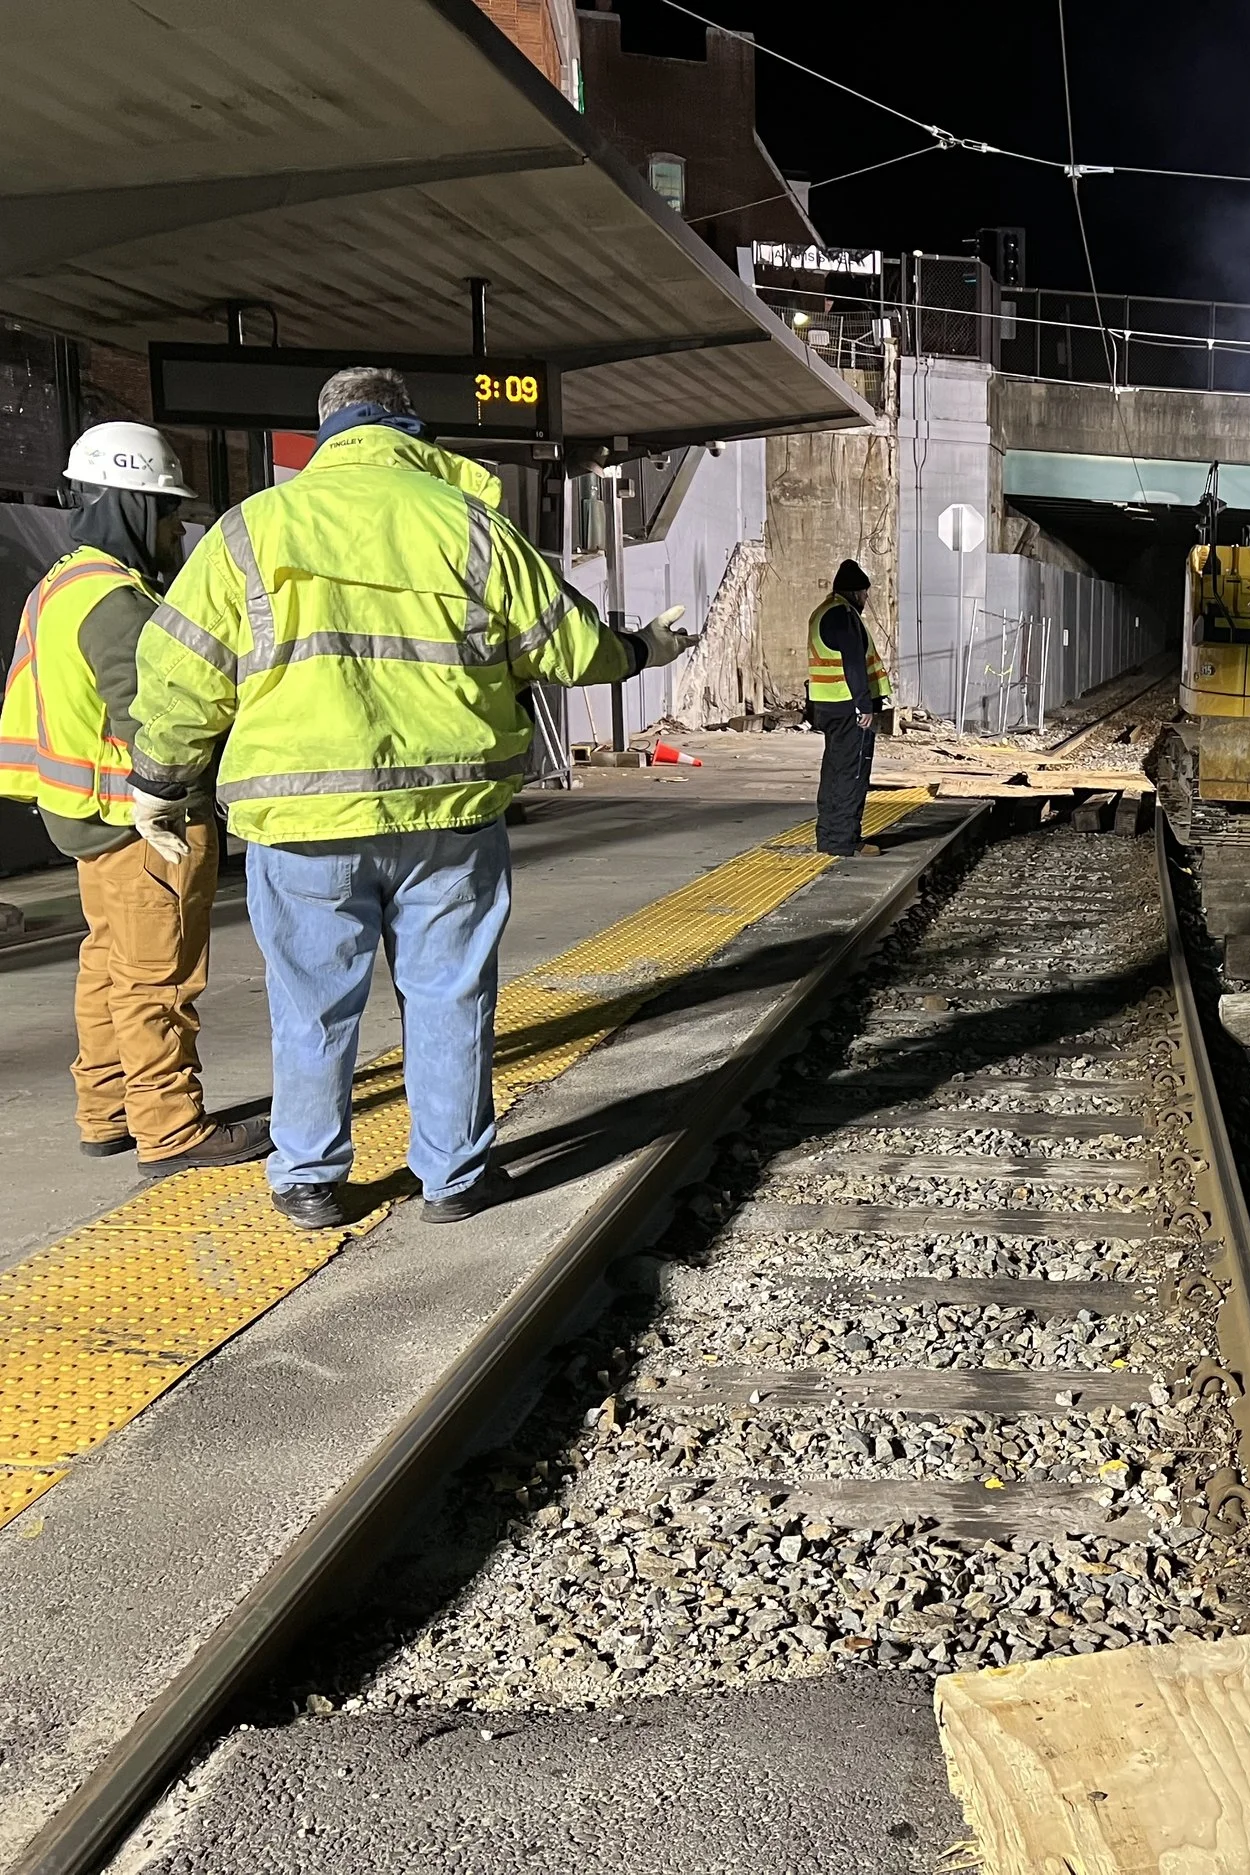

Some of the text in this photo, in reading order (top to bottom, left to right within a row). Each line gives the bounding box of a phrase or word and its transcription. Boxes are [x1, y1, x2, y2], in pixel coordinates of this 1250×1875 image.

[475, 374, 538, 403] 3:09
[329, 438, 363, 449] TINGLEY
[113, 453, 154, 473] GLX
